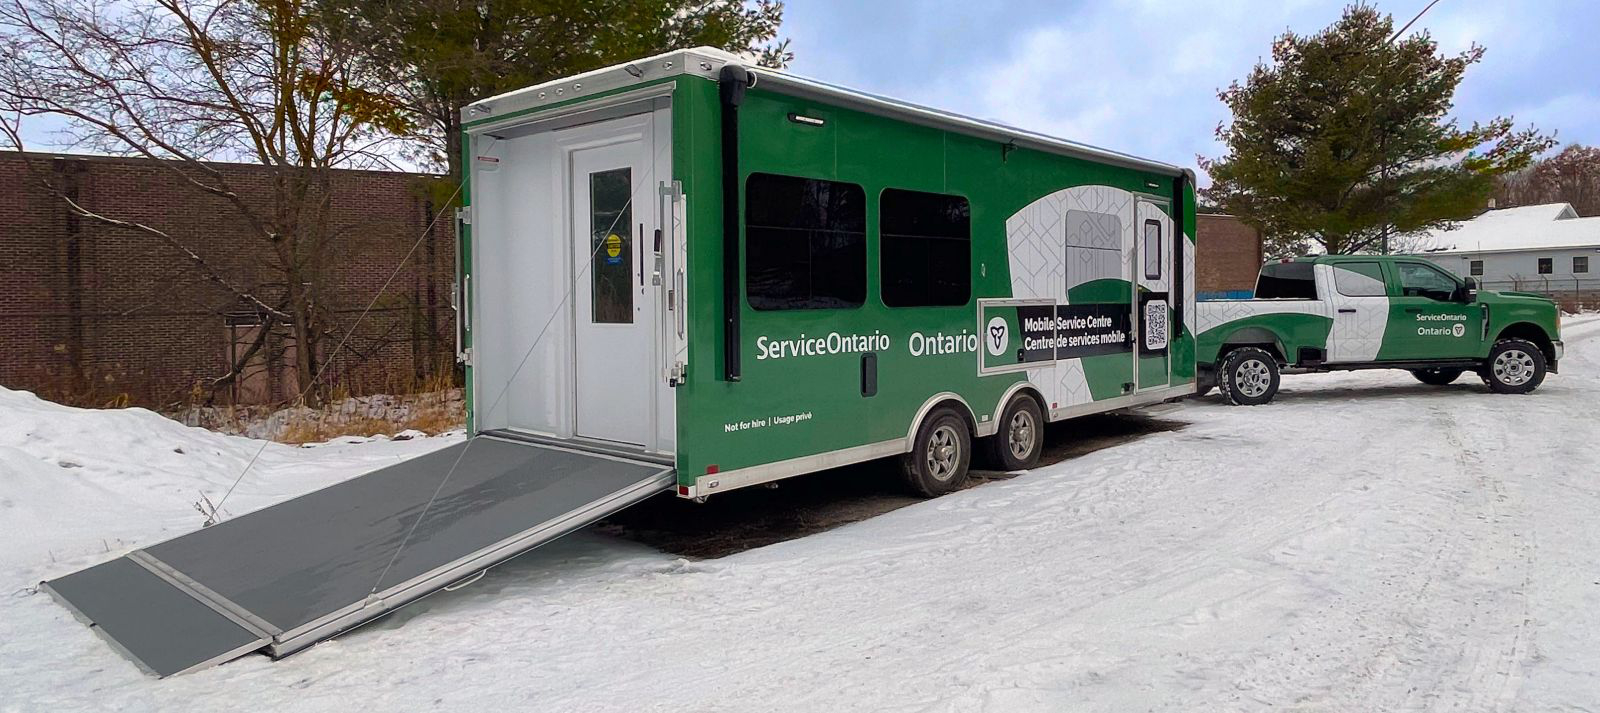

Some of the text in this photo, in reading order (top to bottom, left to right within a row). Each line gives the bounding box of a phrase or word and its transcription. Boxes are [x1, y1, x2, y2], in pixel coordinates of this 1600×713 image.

[1024, 315, 1112, 332] Mobile Service Centre
[1416, 313, 1467, 321] ServiceOntario
[1024, 330, 1126, 350] Centre de services mobile
[1417, 327, 1451, 335] Ontario
[756, 330, 890, 360] ServiceOntario
[908, 329, 977, 356] Ontario
[724, 412, 813, 433] Not for hire Usage privé
